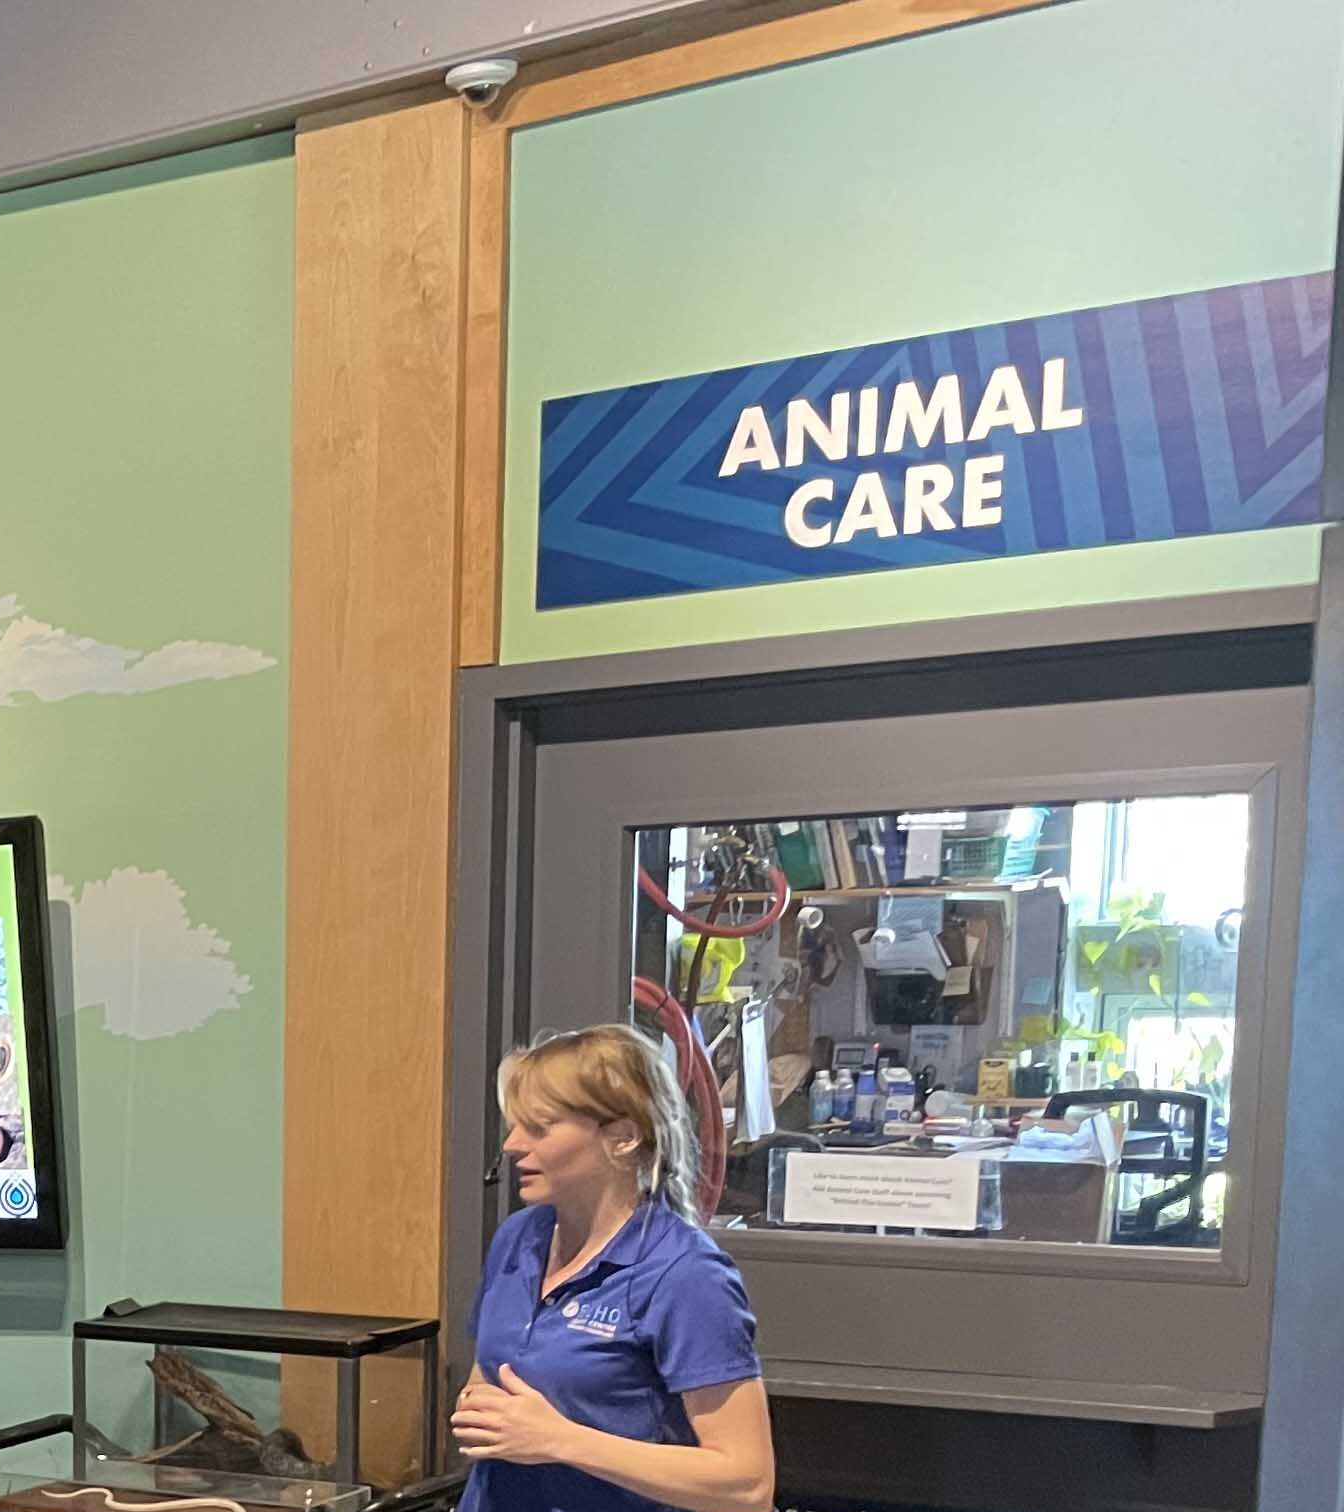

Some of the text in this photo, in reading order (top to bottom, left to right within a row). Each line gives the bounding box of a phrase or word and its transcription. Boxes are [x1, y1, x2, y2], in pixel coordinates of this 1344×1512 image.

[718, 357, 1084, 478] ANIMAL
[783, 454, 1005, 548] CARE
[581, 1303, 622, 1324] EHO
